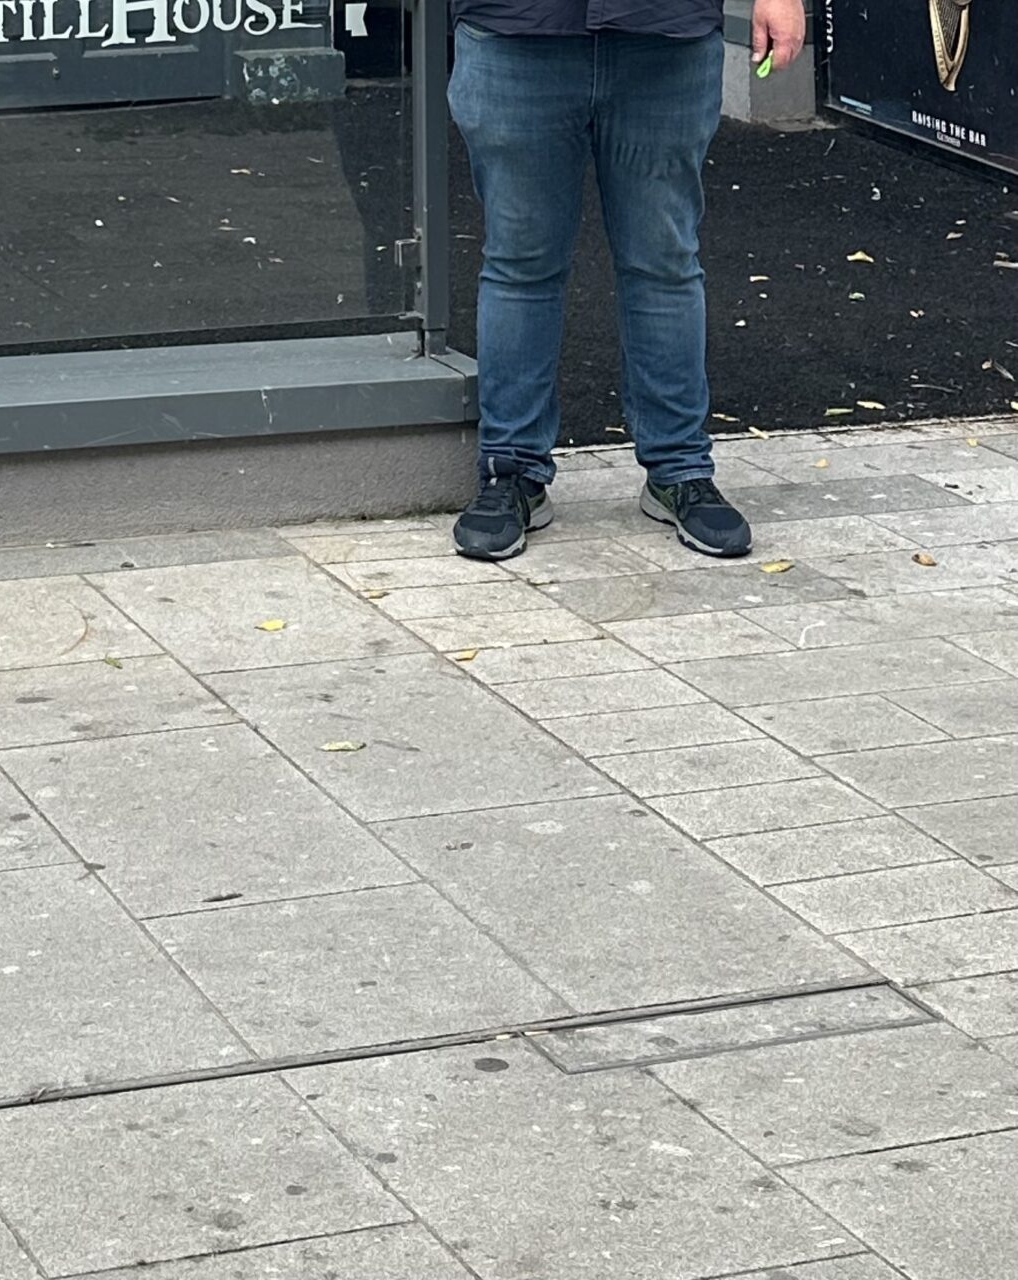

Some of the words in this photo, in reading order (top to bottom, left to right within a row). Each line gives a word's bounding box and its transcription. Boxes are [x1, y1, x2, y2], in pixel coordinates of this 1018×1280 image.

[912, 110, 947, 133] RAISING
[949, 122, 966, 140] THE
[968, 129, 987, 147] BAR
